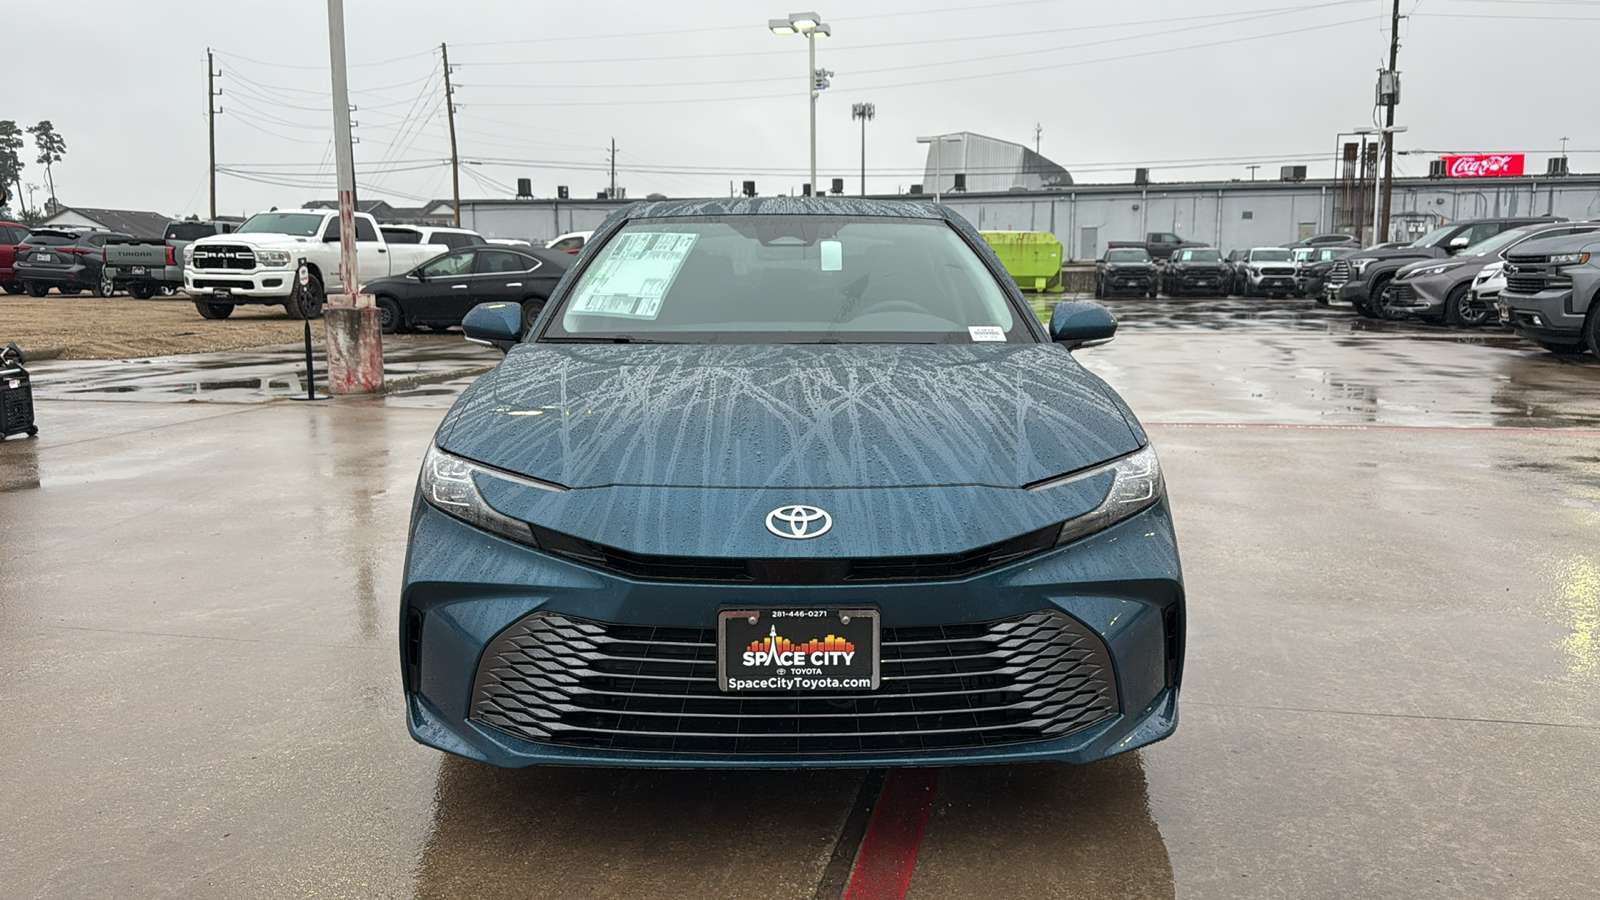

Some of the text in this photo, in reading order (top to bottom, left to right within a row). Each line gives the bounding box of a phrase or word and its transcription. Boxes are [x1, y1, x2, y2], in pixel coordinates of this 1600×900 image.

[772, 610, 828, 618] 281-446-0271
[742, 651, 856, 666] SPACE CITY
[728, 677, 871, 690] SpaceCityToyota.com
